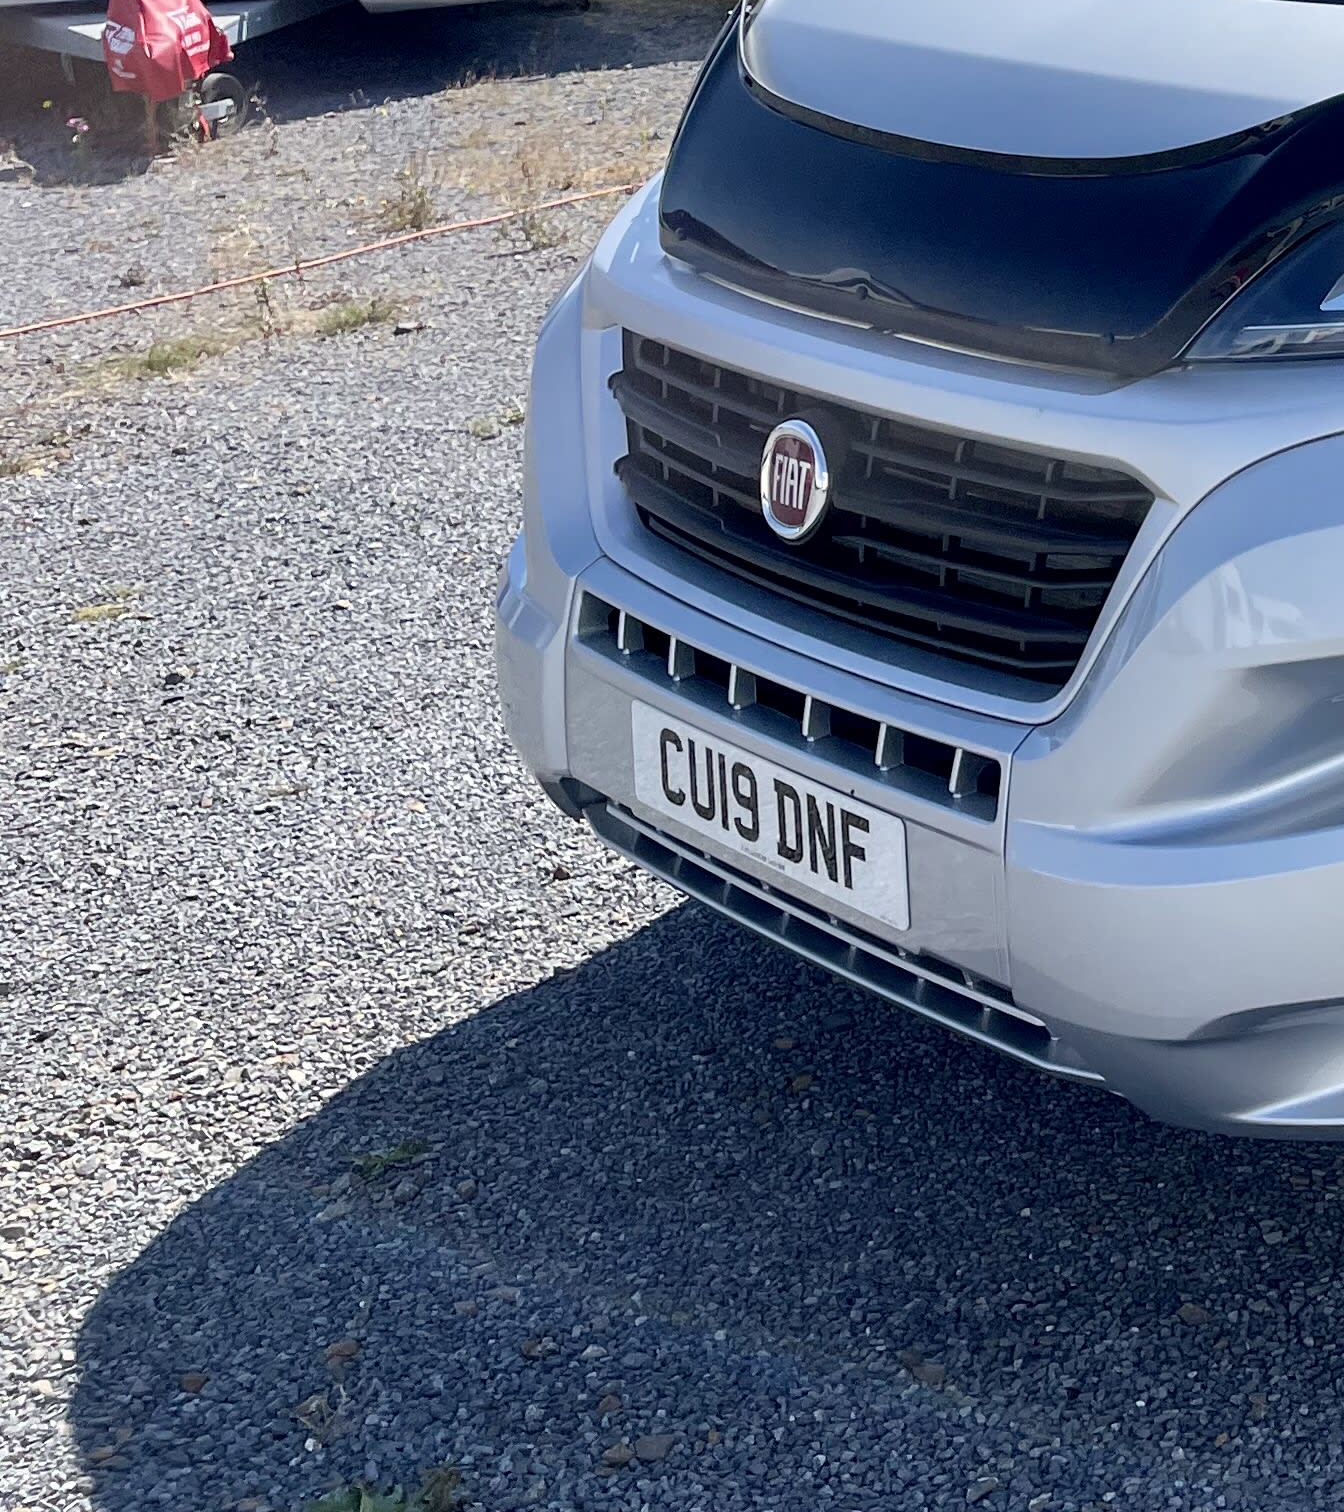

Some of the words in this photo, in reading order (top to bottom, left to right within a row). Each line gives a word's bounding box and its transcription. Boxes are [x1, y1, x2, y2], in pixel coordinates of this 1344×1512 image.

[772, 452, 812, 511] FIAT
[659, 727, 760, 842] CU19
[773, 777, 871, 890] DNF
